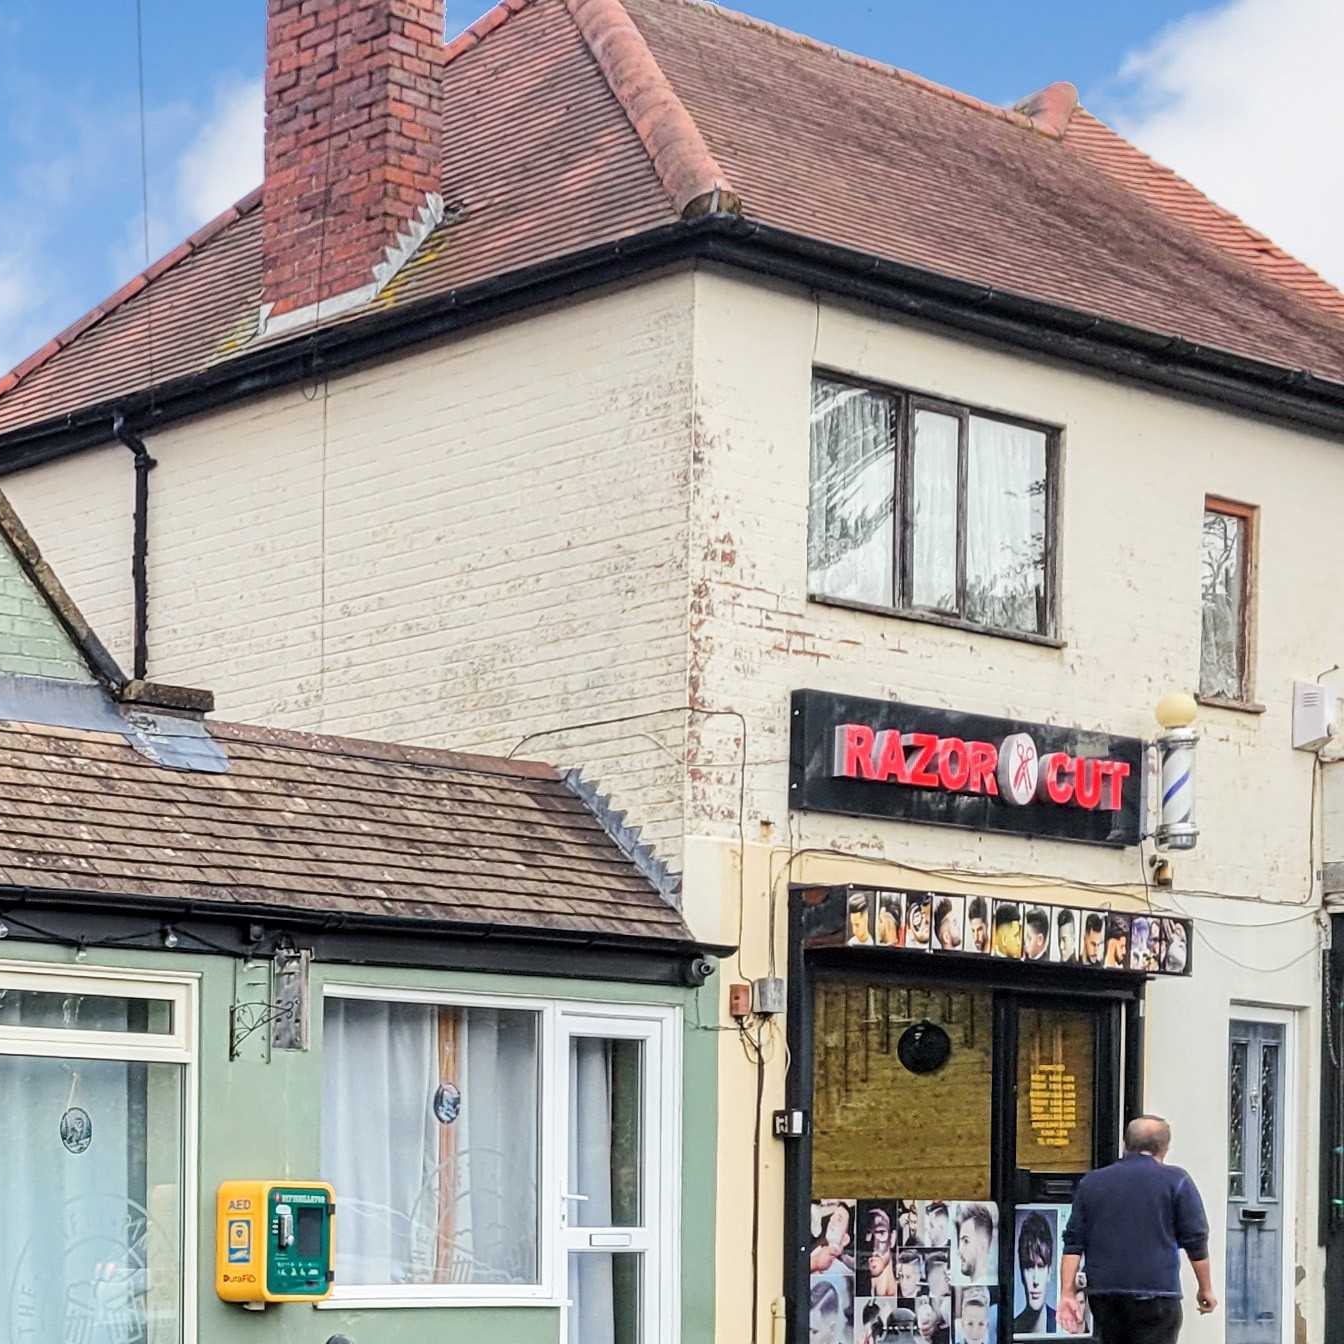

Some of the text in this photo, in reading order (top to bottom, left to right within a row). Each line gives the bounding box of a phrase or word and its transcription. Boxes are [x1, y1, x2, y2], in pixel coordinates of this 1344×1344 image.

[841, 723, 1131, 811] RAZOR CUT
[227, 1199, 252, 1211] AED
